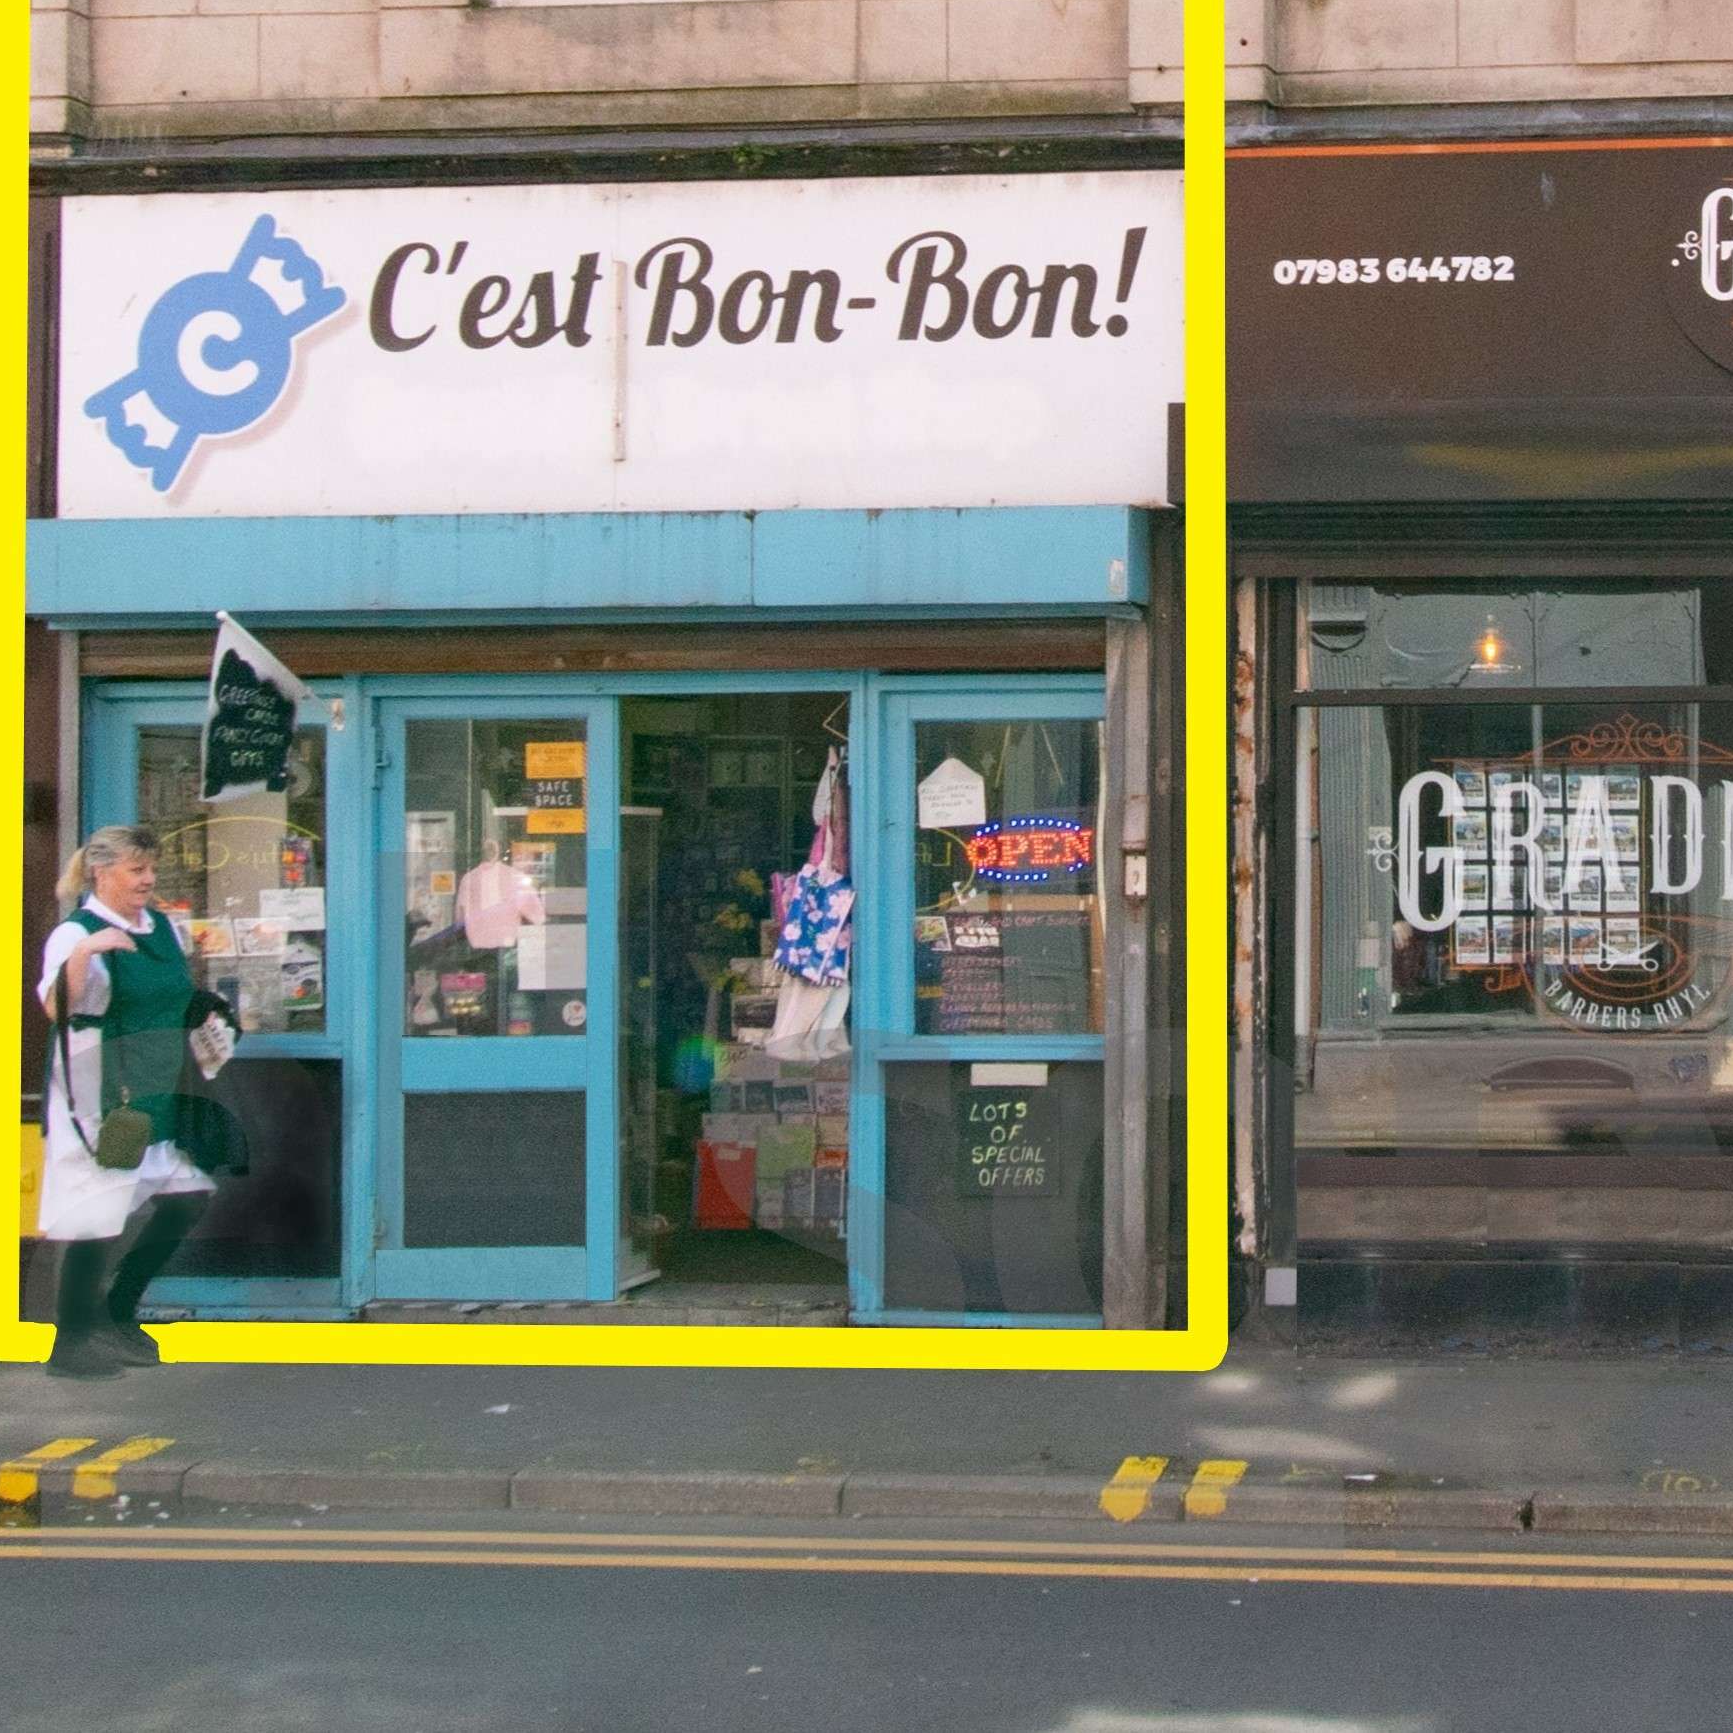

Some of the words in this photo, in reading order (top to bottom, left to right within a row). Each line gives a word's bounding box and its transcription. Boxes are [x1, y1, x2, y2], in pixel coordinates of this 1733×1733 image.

[1273, 257, 1381, 285] 07983
[1385, 255, 1515, 283] 644782
[367, 240, 602, 353] C'est
[633, 224, 1148, 345] Bon-Bon!
[537, 780, 570, 793] SAFE
[535, 794, 573, 807] SPACE
[967, 830, 1093, 867] OPEN
[1544, 979, 1642, 1030] BARBERS
[1652, 983, 1712, 1025] RHYL
[969, 1101, 1028, 1122] LOTS
[990, 1125, 1023, 1143] OF
[971, 1146, 1047, 1165] SPECIAL
[978, 1167, 1046, 1186] OFFERS
